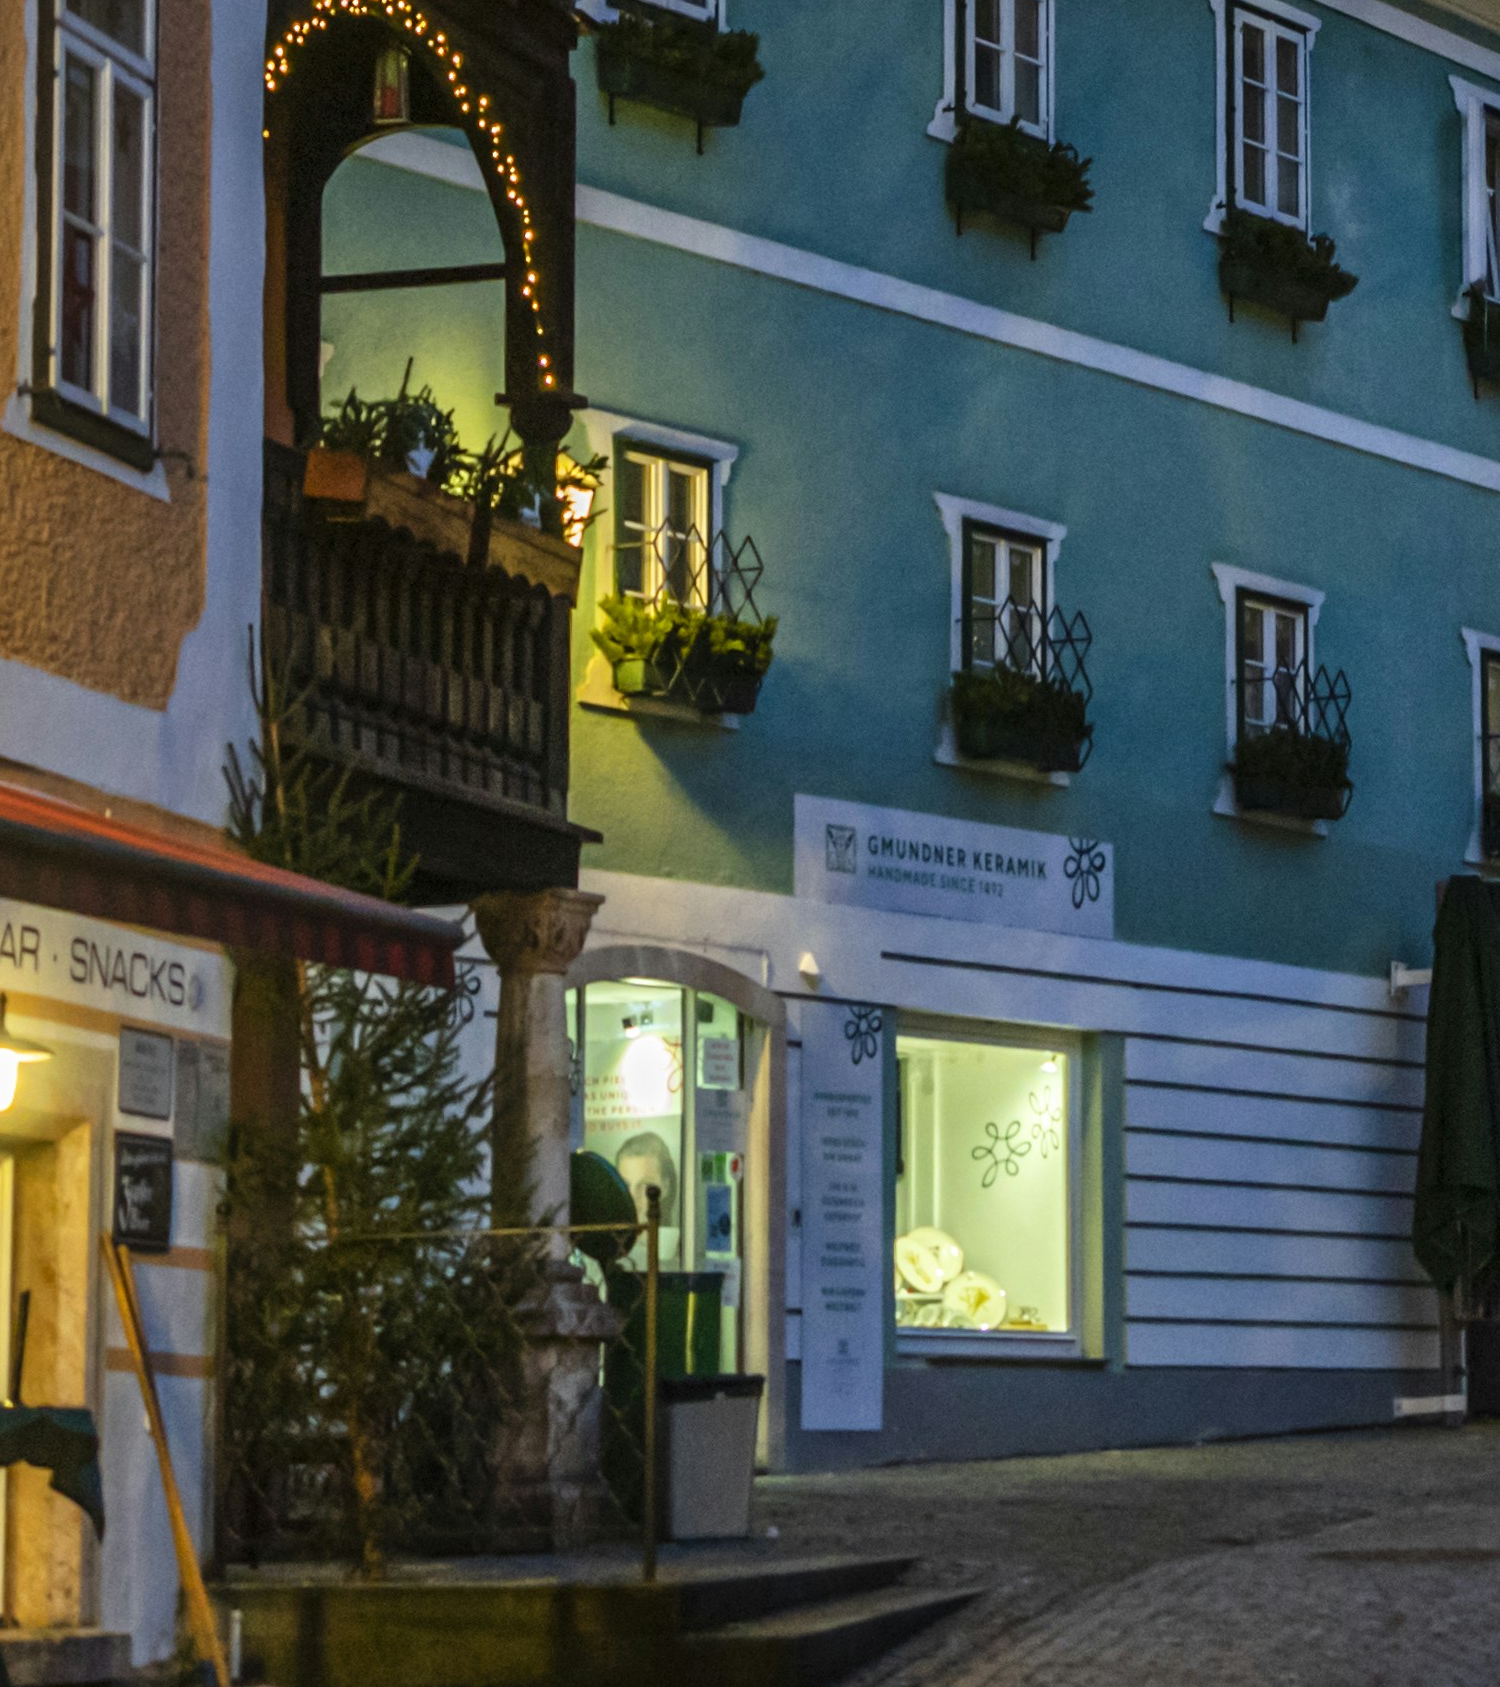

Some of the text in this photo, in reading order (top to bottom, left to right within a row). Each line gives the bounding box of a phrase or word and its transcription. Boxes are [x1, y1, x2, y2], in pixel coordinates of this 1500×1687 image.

[867, 835, 1048, 880] GMUNDNER KERAMIK
[867, 865, 938, 888] HANDMADE
[939, 873, 976, 894] SINCE
[70, 938, 187, 1006] SNACKS
